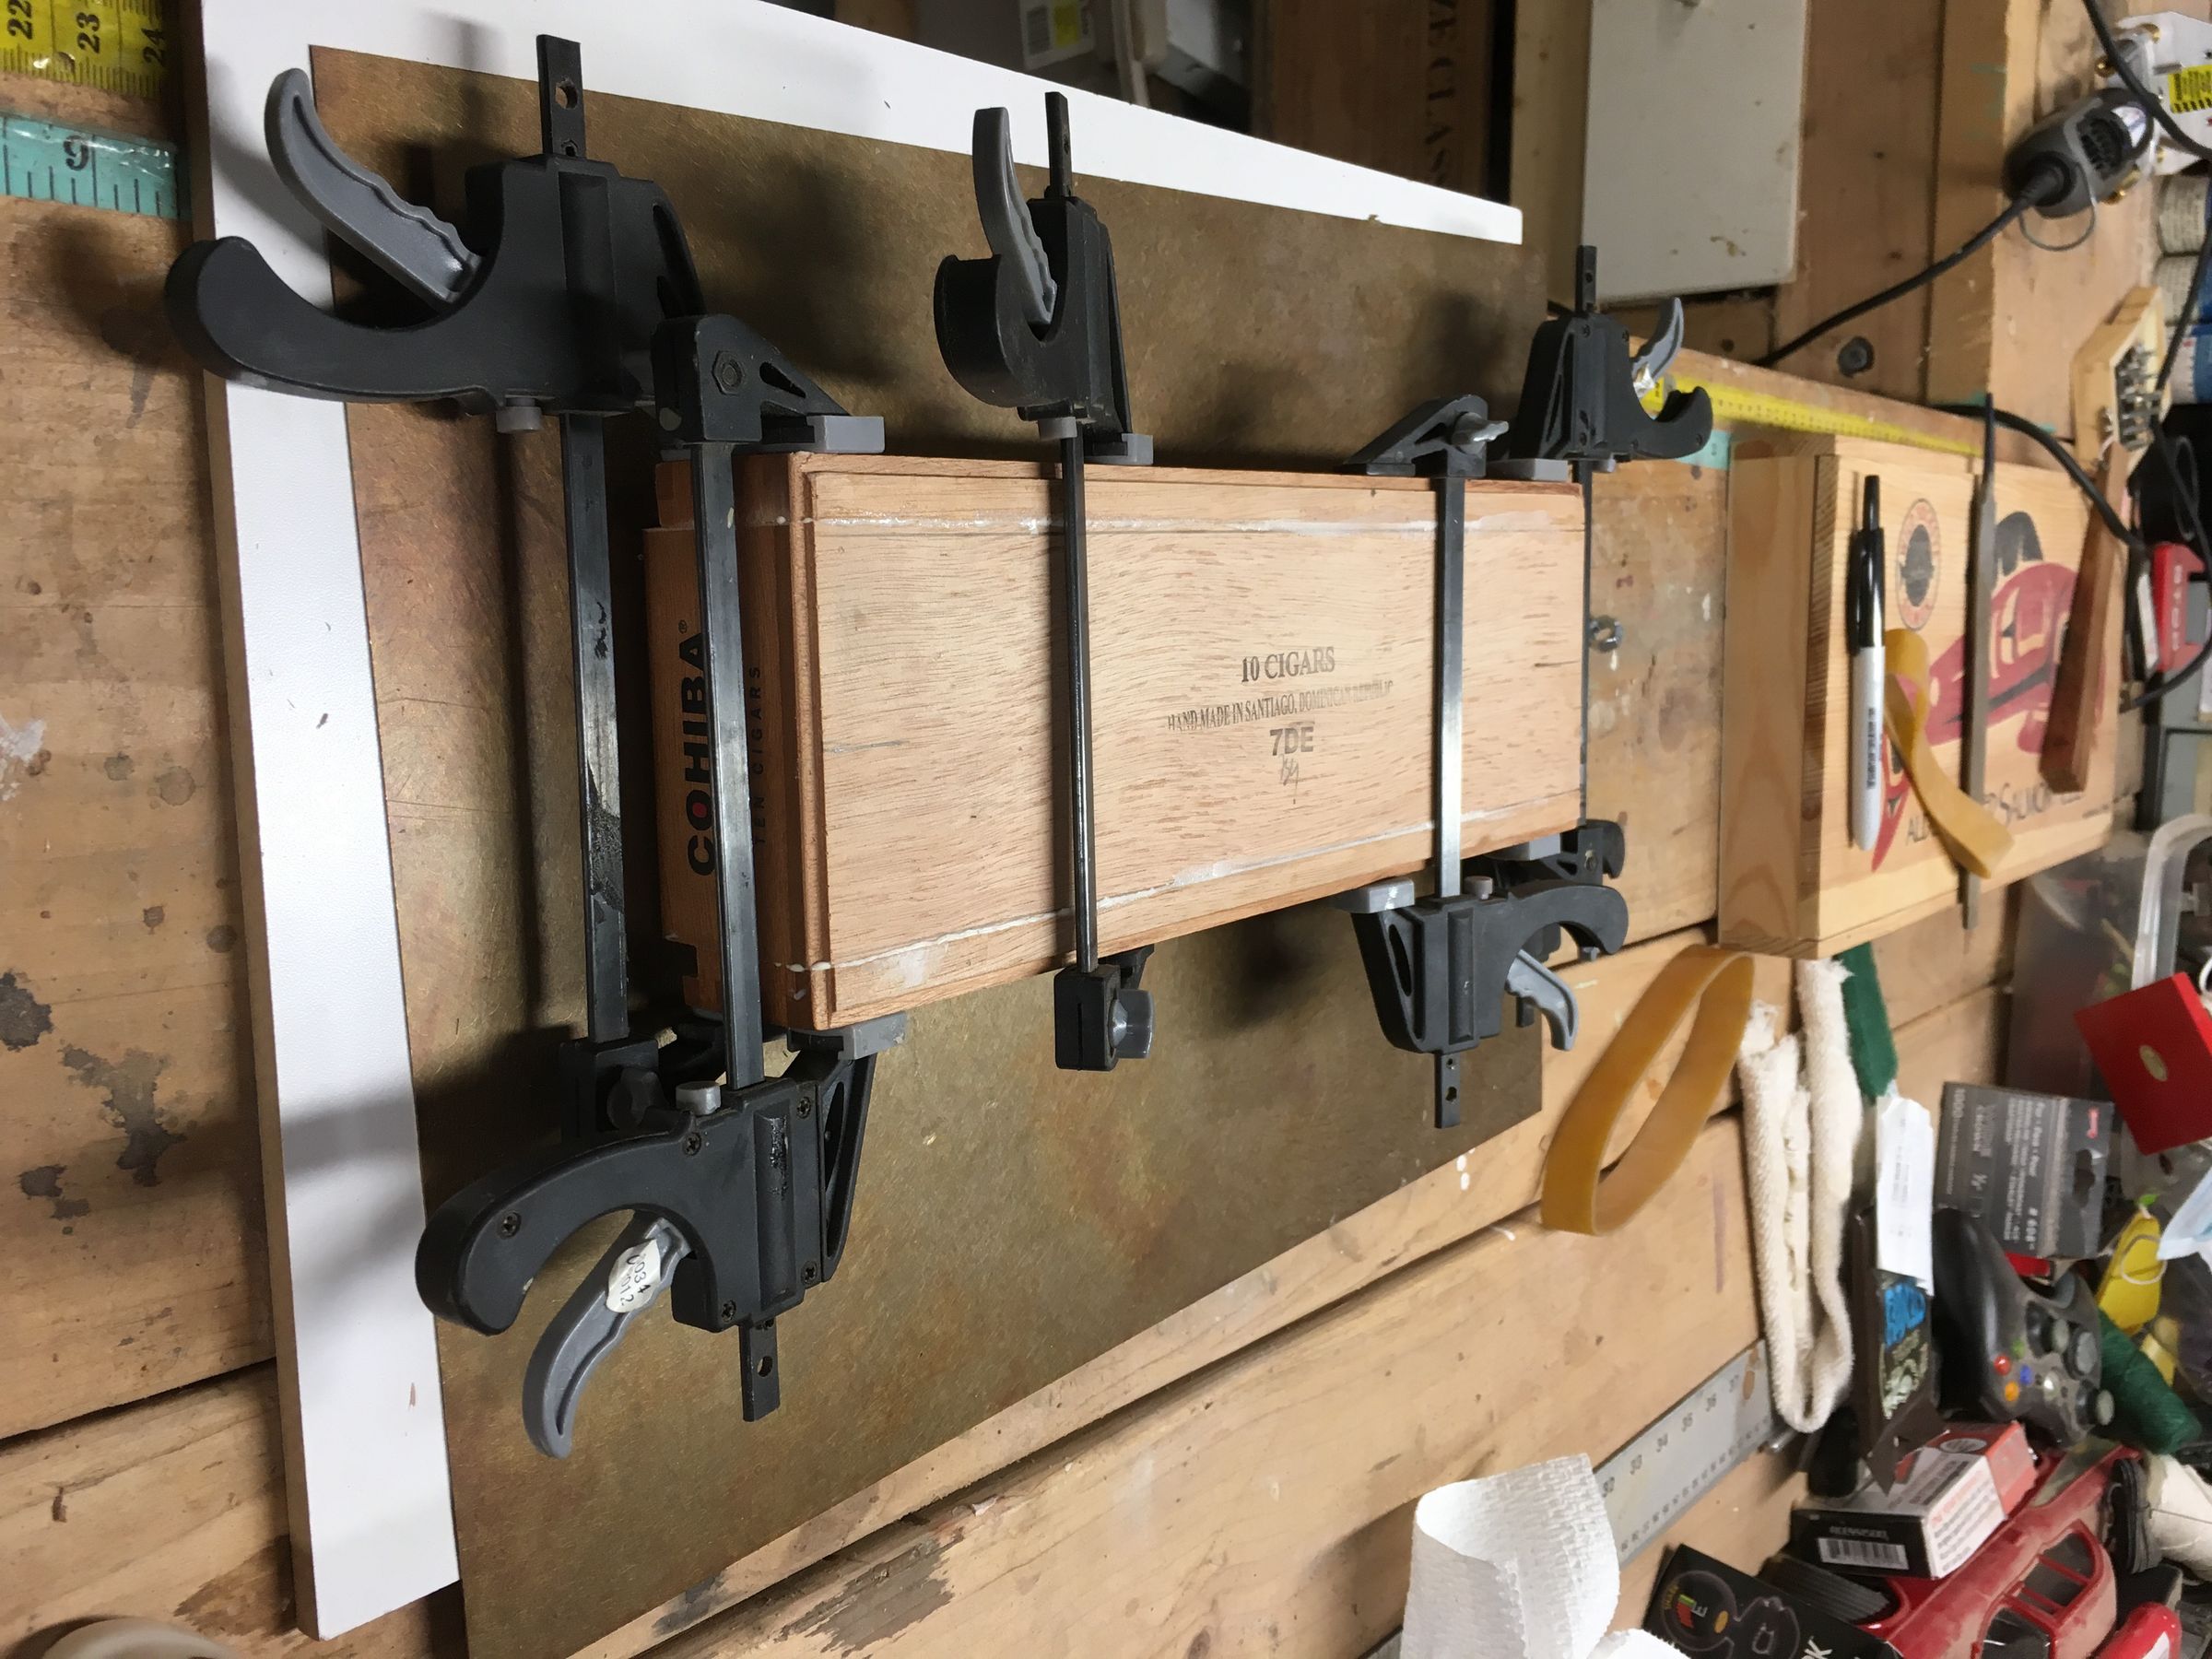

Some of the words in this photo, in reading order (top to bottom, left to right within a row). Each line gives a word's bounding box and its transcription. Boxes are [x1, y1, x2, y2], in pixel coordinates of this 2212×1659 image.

[6, 0, 33, 40] 22
[76, 12, 101, 54] 23
[141, 26, 167, 66] 24
[63, 135, 90, 171] 9
[1241, 655, 1260, 683] 10
[1264, 646, 1335, 678] CIGARS
[749, 666, 765, 775] CIGARS
[1167, 710, 1198, 731] HAND
[1199, 704, 1230, 730] MADE
[1232, 701, 1244, 724] IN
[1245, 693, 1298, 722] SANTIAGO,
[678, 632, 715, 876] COHIBA
[1269, 726, 1314, 756] 7DE
